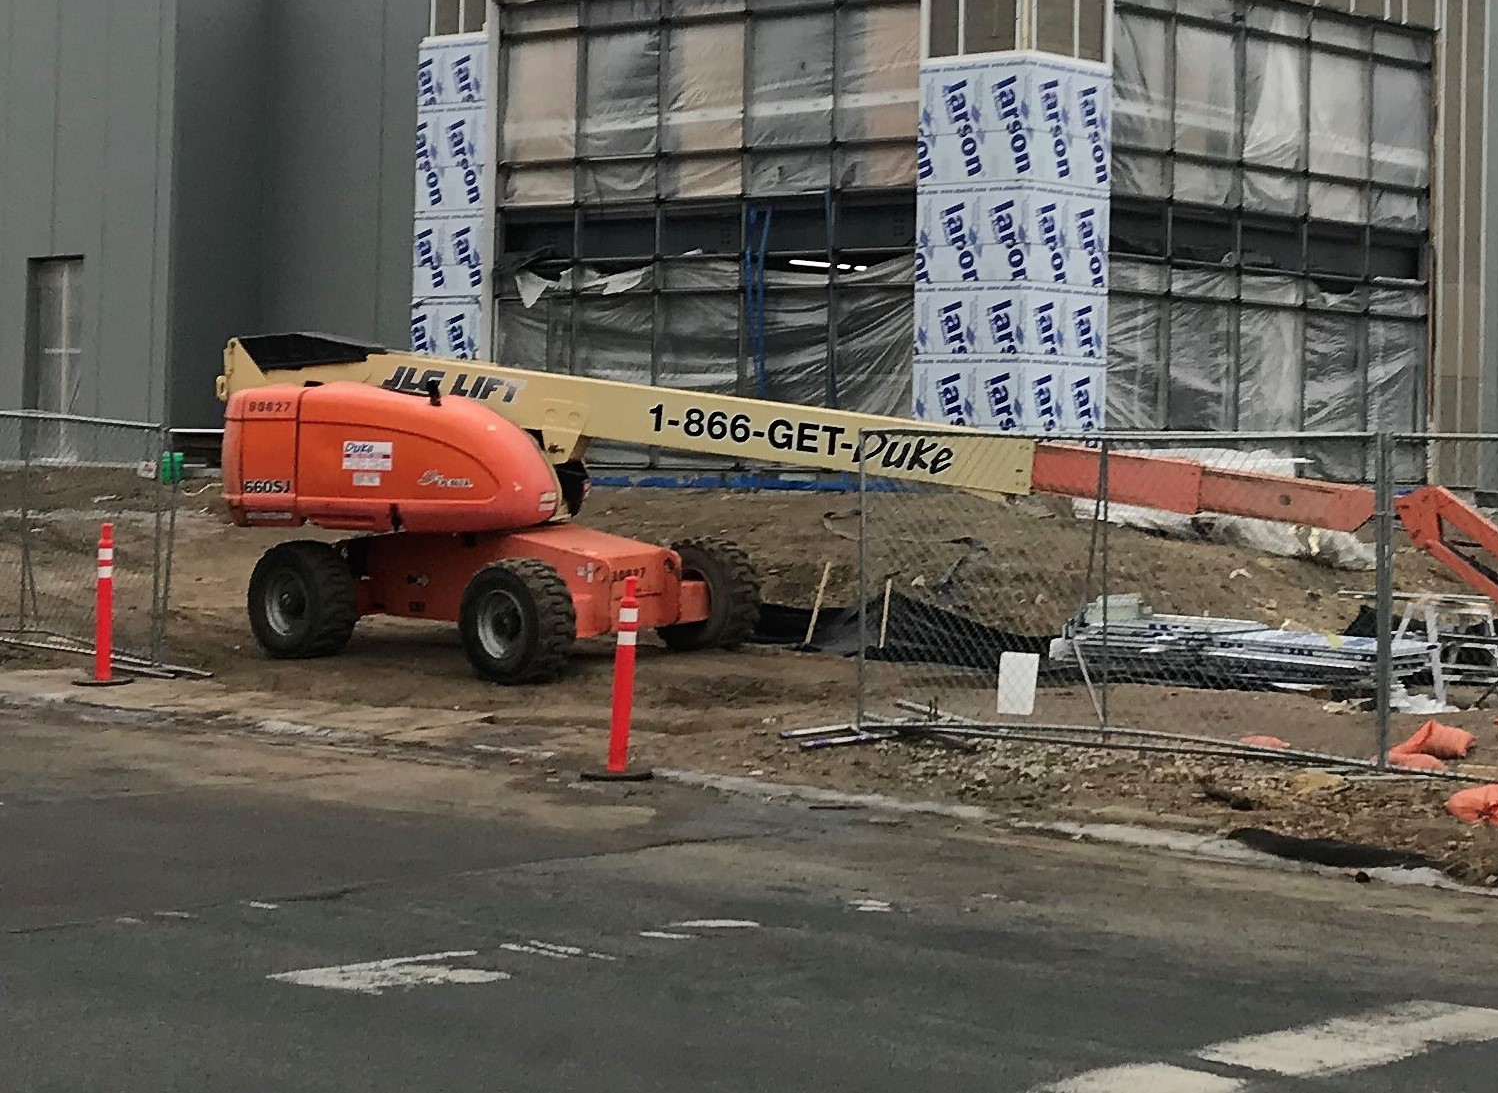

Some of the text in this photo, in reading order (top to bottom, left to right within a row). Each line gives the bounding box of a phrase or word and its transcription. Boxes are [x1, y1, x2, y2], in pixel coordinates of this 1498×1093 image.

[949, 79, 983, 177] larson
[994, 75, 1032, 174] larson
[1042, 79, 1070, 178] larson
[1080, 86, 1108, 183] larson
[380, 366, 528, 403] JLG LIFT
